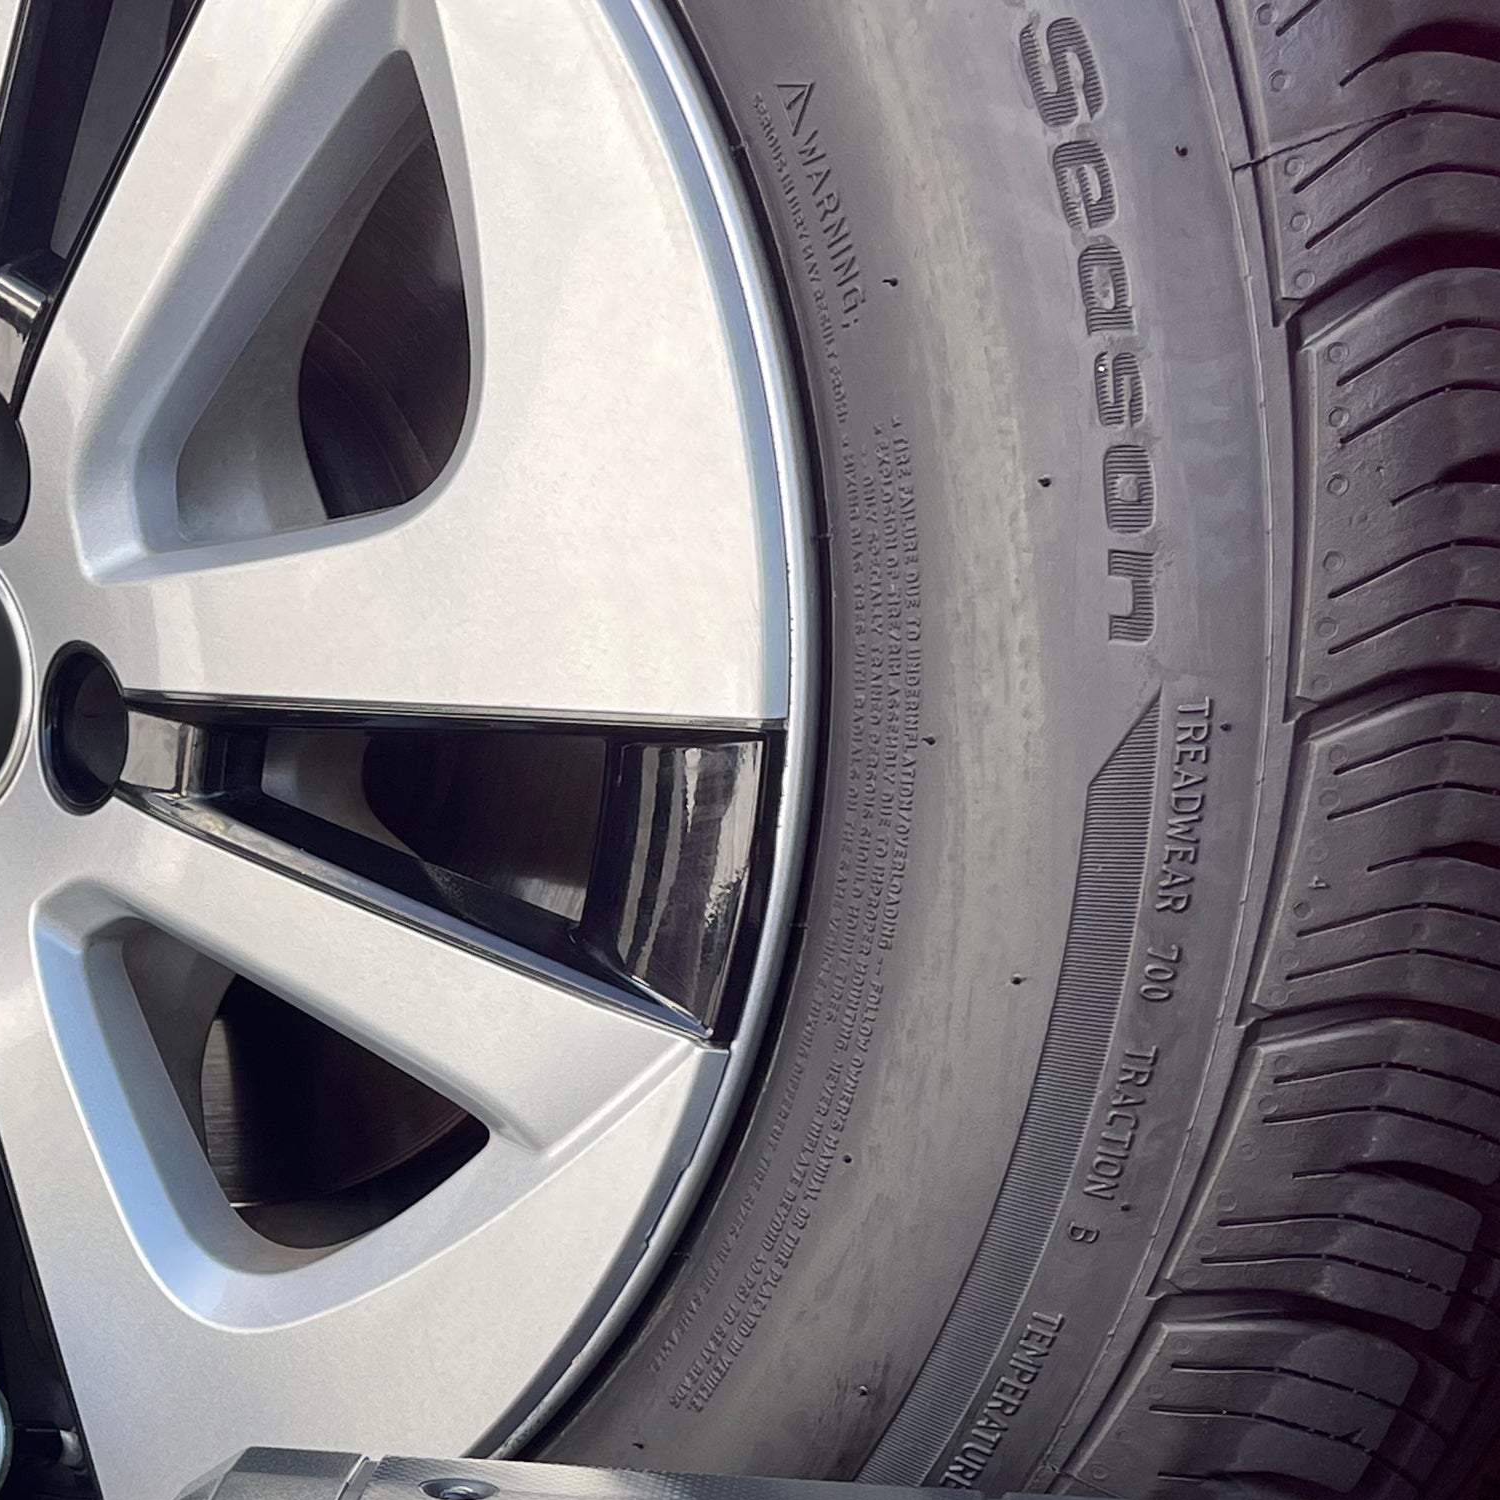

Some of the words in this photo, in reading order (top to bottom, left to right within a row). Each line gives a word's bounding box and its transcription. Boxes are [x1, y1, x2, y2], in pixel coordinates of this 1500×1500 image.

[802, 244, 821, 282] MAY
[1019, 16, 1156, 646] Season
[893, 438, 911, 479] TIRE
[876, 446, 898, 550] EXPLOSION
[898, 487, 919, 563] FAILURE
[868, 530, 883, 636] SPECIALLY
[886, 556, 900, 580] OF
[906, 570, 921, 608] DUE
[906, 617, 921, 642] TO
[869, 648, 883, 726] TRAINED
[882, 684, 901, 785] ASSEMBLY
[846, 788, 859, 812] ON
[862, 734, 881, 820] PERSONS
[1155, 696, 1211, 913] TREADWEAR
[843, 822, 856, 854] THE
[878, 793, 894, 828] DUE
[852, 827, 872, 899] SHOULD
[875, 838, 889, 858] TO
[839, 905, 860, 963] MOUNT
[858, 866, 885, 957] IMPROPER
[1140, 943, 1180, 1002] 700
[856, 980, 884, 1053] FOLLOW
[816, 1059, 843, 1117] NEVER
[831, 1055, 865, 1133] OWNER'S
[1083, 1045, 1158, 1200] TRACTION
[753, 1156, 771, 1192] TIRE
[789, 1119, 824, 1188] INFLATE
[803, 1134, 840, 1201] MANUAL
[762, 1188, 797, 1252] BEYOND
[791, 1204, 811, 1230] OR
[1067, 1221, 1099, 1244] B
[774, 1231, 800, 1269] TIRE
[703, 1265, 720, 1295] THE
[734, 1274, 756, 1304] PSI
[738, 1268, 783, 1339] PLACARD
[723, 1304, 740, 1326] TO
[701, 1327, 727, 1365] SEAT
[726, 1335, 744, 1358] IN
[669, 1360, 704, 1409] BEADS
